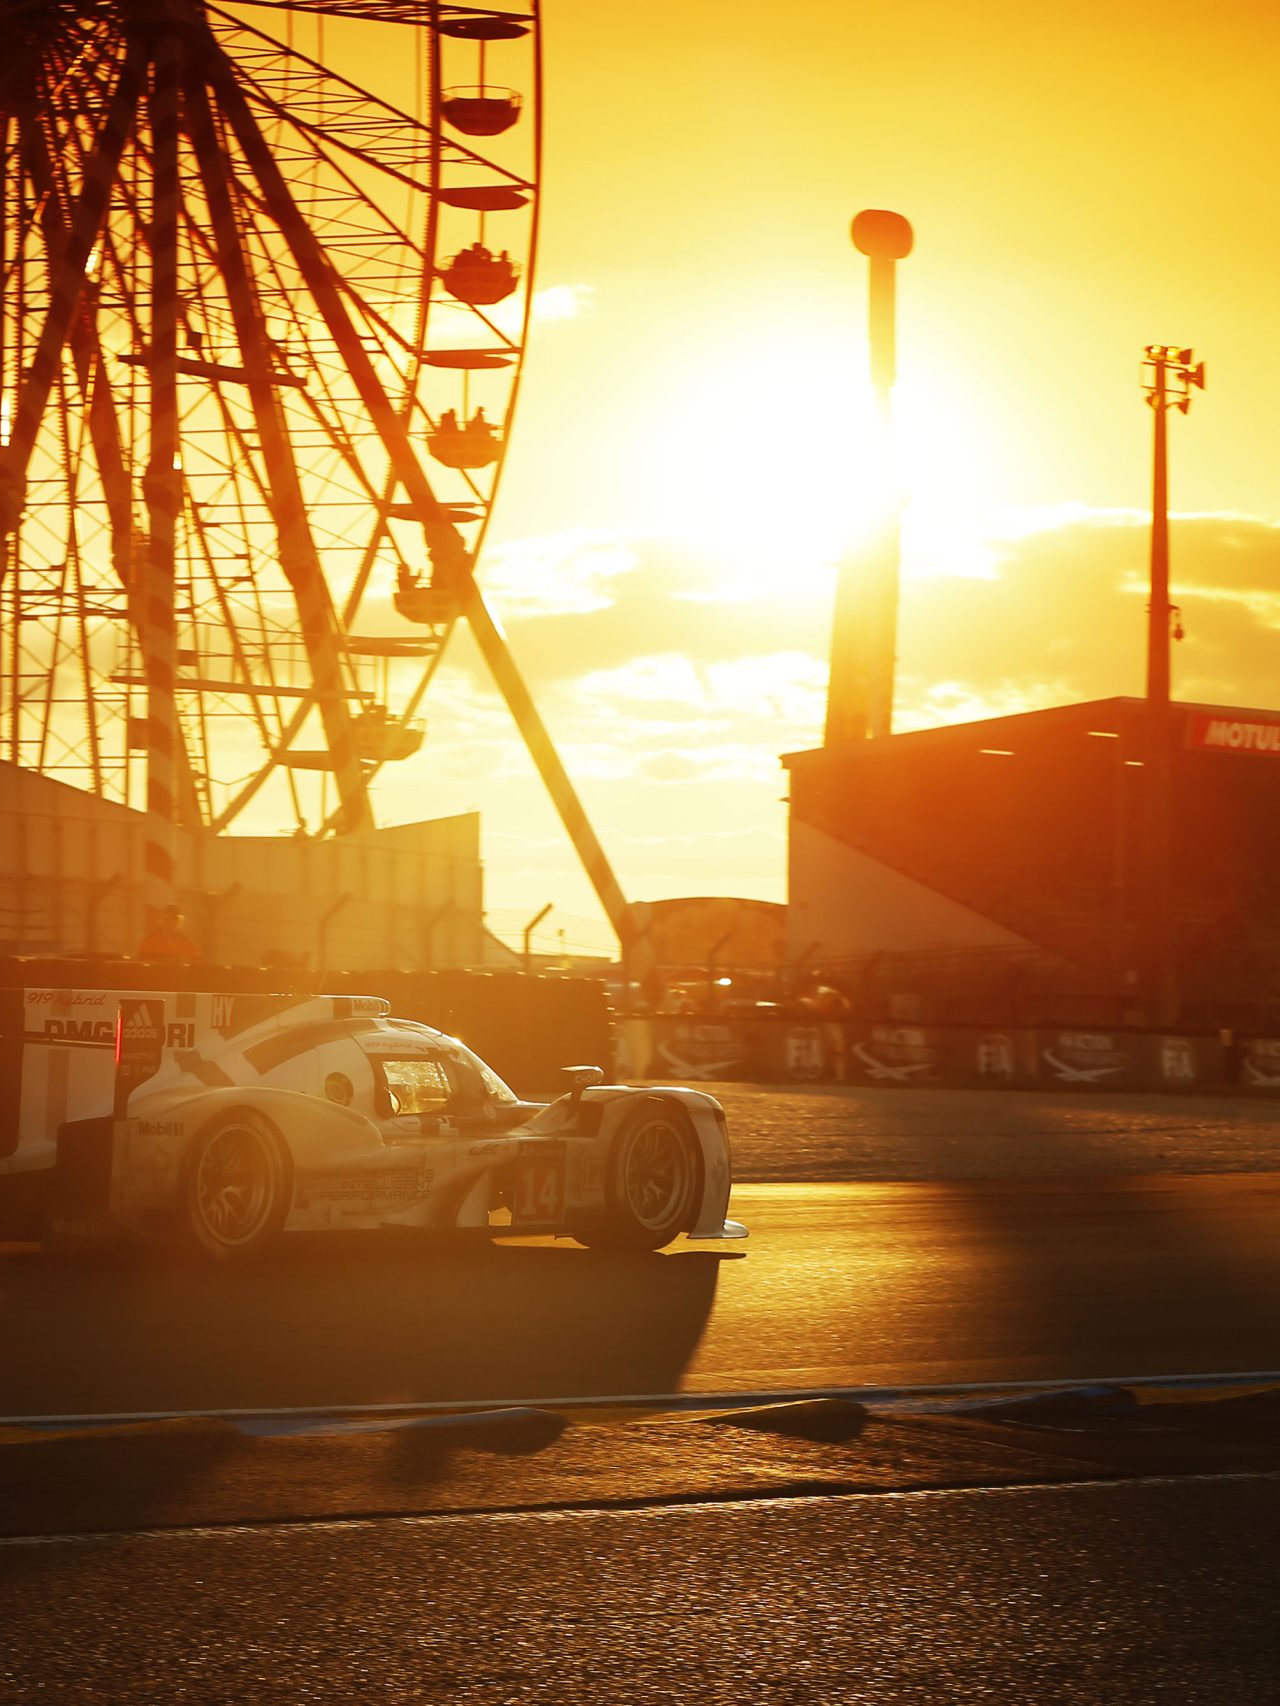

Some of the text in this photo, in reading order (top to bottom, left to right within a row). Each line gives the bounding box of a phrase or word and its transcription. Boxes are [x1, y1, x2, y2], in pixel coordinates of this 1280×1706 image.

[1205, 720, 1280, 751] MOTUL
[28, 992, 53, 1004] 919
[213, 997, 234, 1027] HY
[123, 1027, 158, 1039] adidas
[163, 1023, 195, 1048] RI
[138, 1121, 172, 1136] Mobil
[521, 1168, 558, 1215] 14
